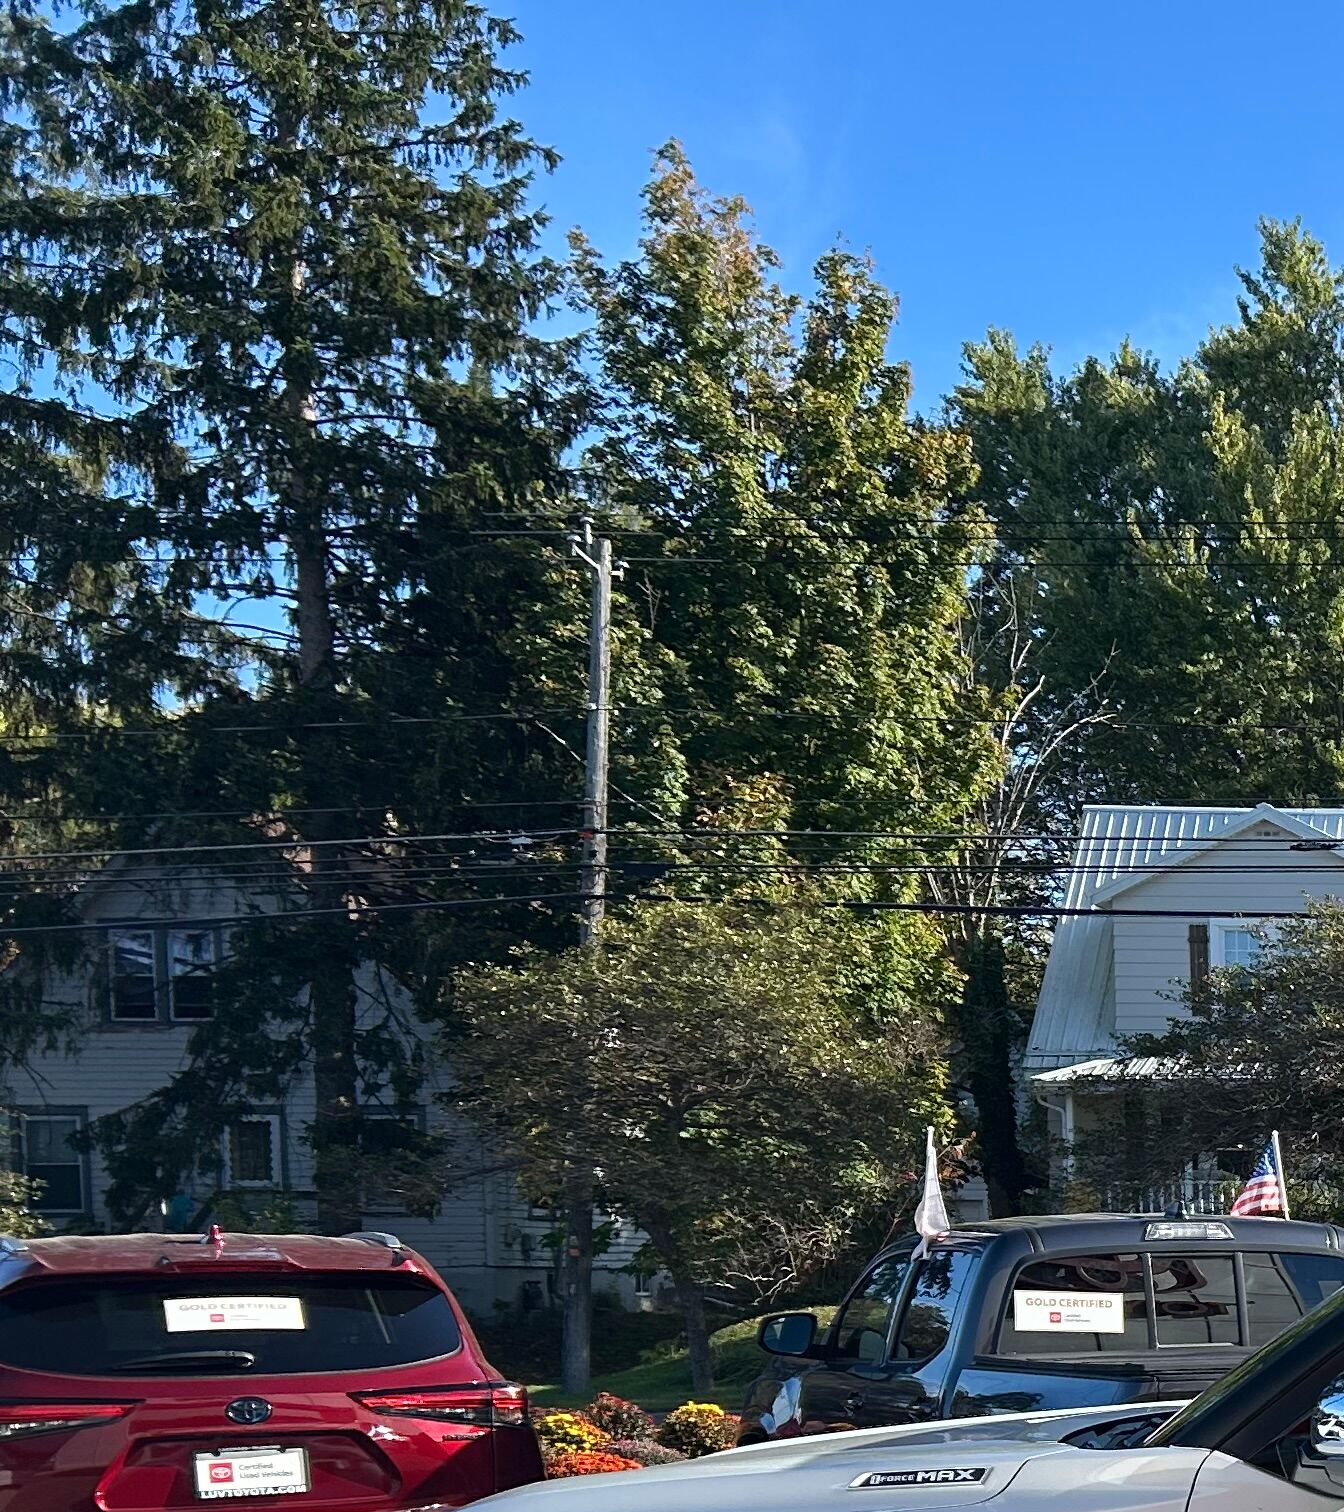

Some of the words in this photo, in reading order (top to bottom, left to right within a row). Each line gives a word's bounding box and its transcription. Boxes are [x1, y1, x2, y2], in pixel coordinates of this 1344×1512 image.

[178, 1303, 217, 1311] GOLD
[1025, 1297, 1057, 1307] GOLD
[1059, 1298, 1113, 1308] CERTIFIED
[238, 1462, 274, 1471] Certified
[916, 1469, 977, 1482] MAX
